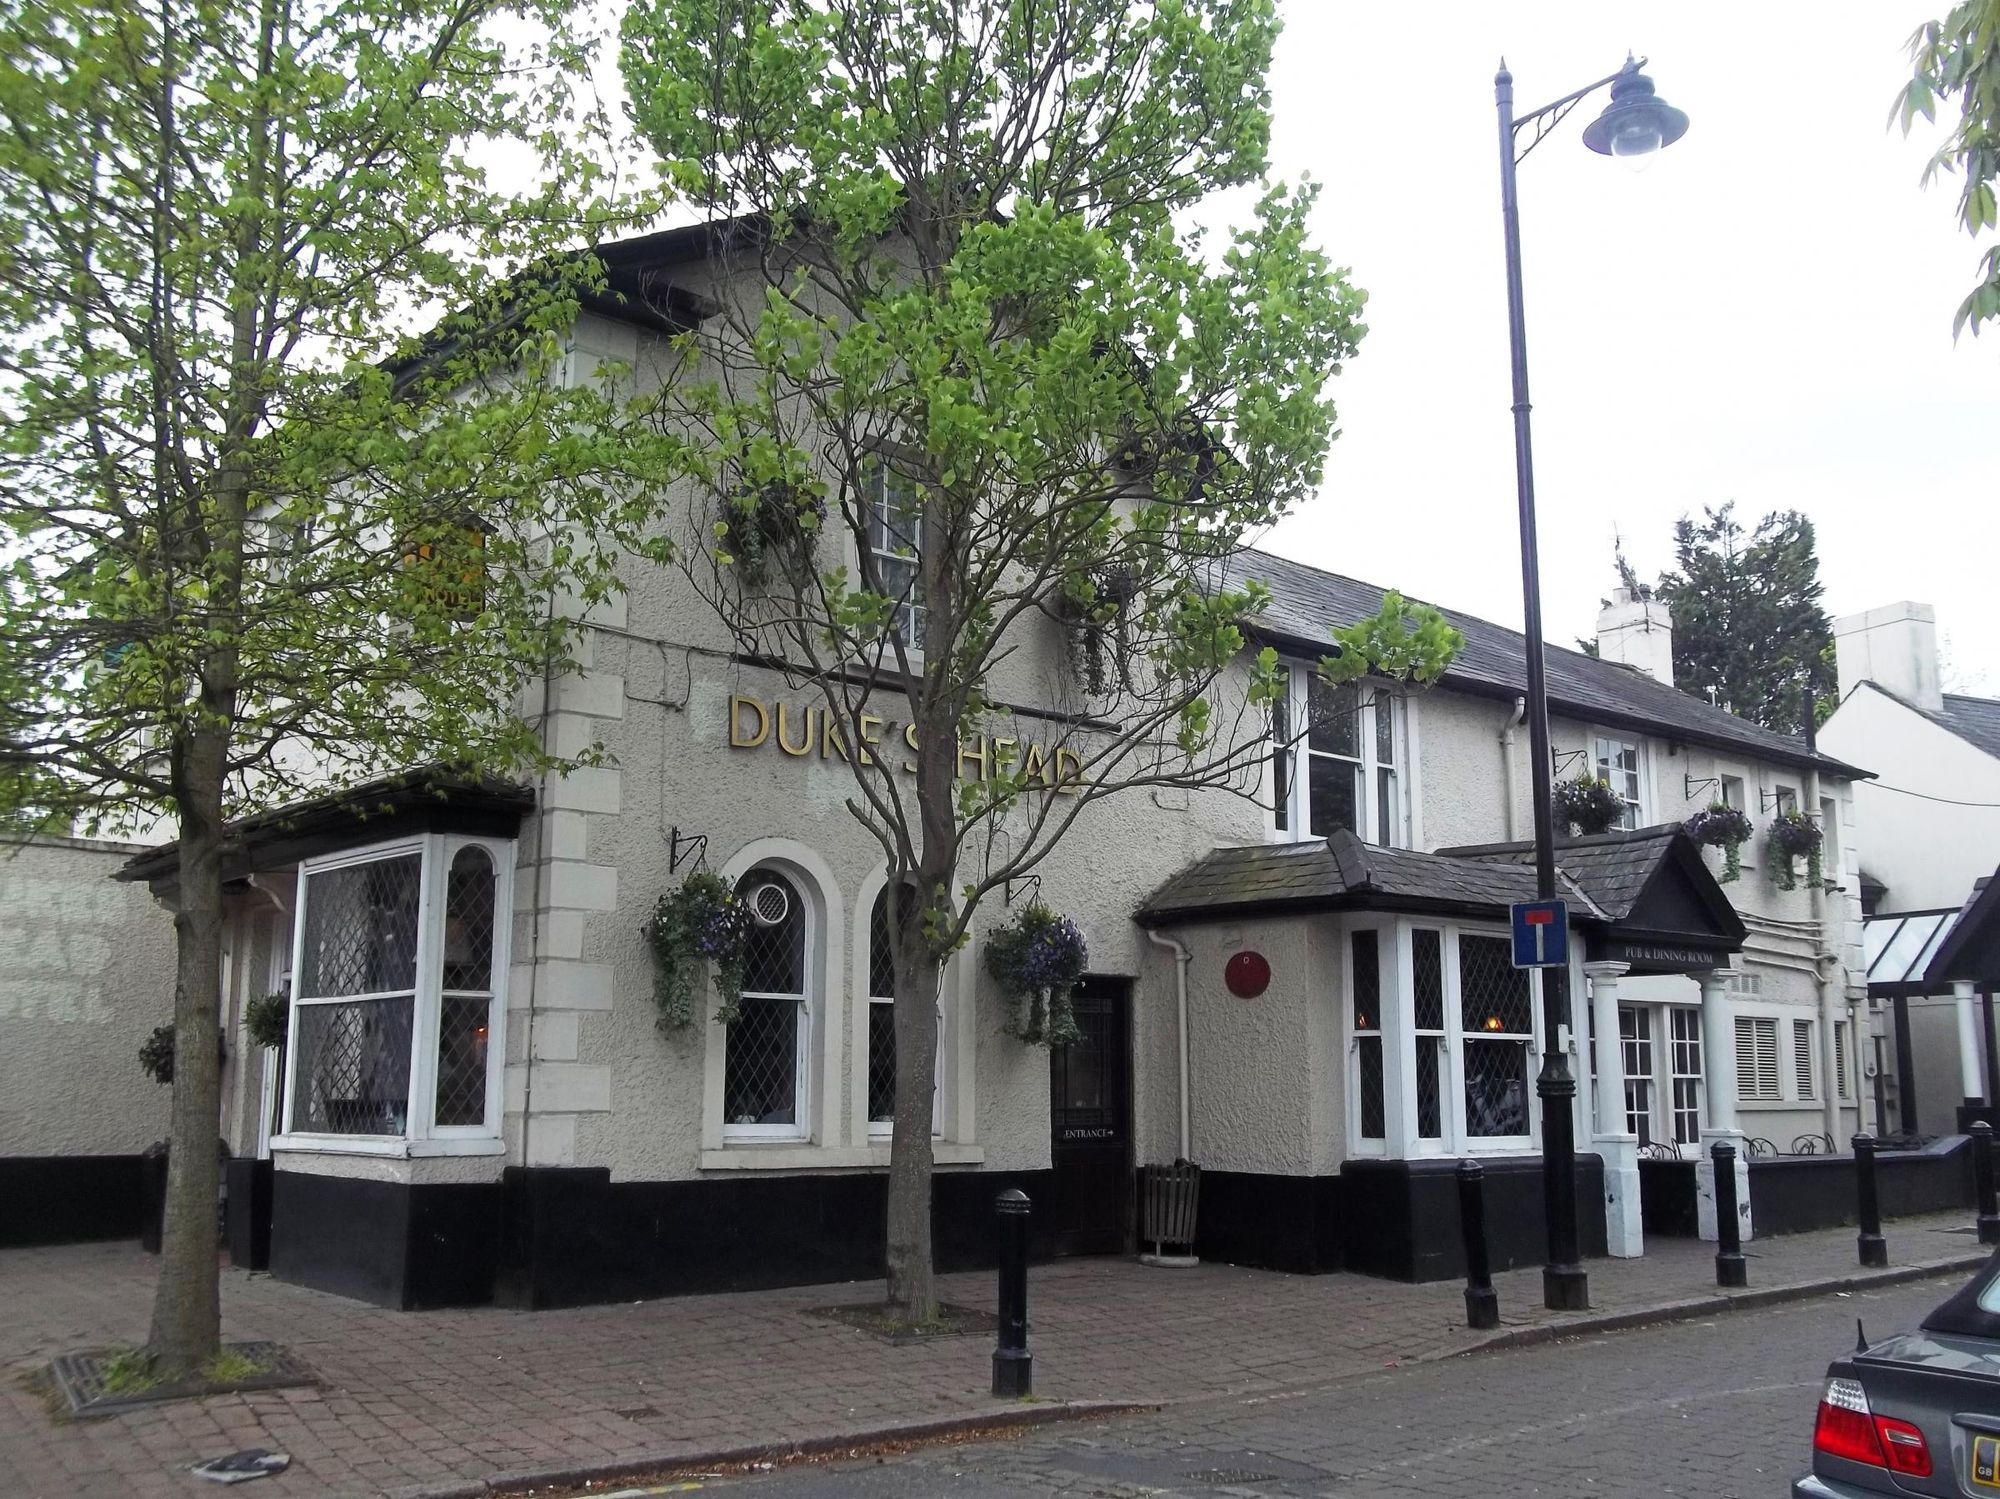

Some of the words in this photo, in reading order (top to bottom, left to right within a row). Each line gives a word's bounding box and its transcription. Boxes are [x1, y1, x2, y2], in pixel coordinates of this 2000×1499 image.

[956, 726, 1084, 795] HEAD
[1625, 946, 1642, 958] PUB
[1644, 948, 1651, 959] &
[1653, 948, 1686, 962] DINING
[1688, 951, 1713, 964] ROOM
[1065, 1129, 1108, 1138] ENTRANCE
[1978, 1466, 1993, 1477] GB
